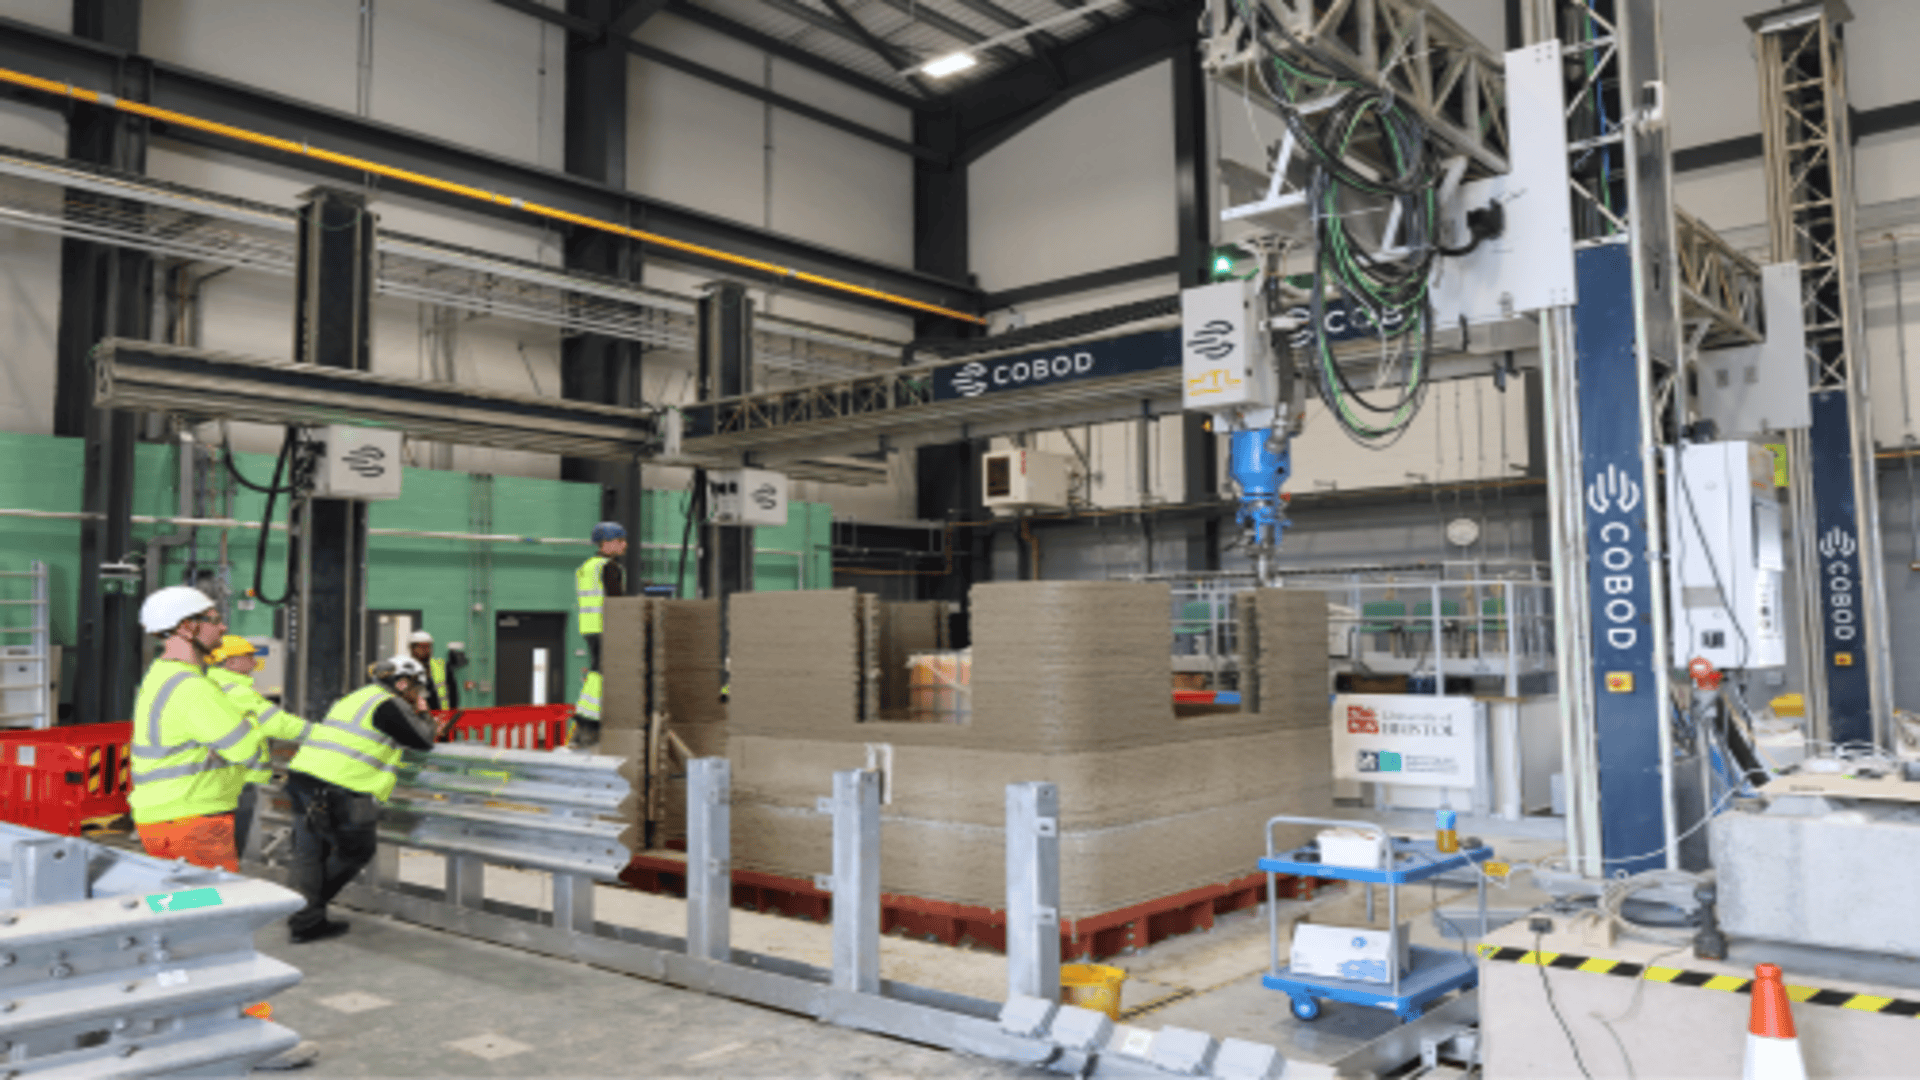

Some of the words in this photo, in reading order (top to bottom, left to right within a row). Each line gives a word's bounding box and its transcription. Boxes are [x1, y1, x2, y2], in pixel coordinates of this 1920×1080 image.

[1324, 305, 1404, 333] COB
[993, 352, 1094, 385] COBOD
[1600, 521, 1638, 650] COBOD
[1828, 560, 1856, 640] COBOD
